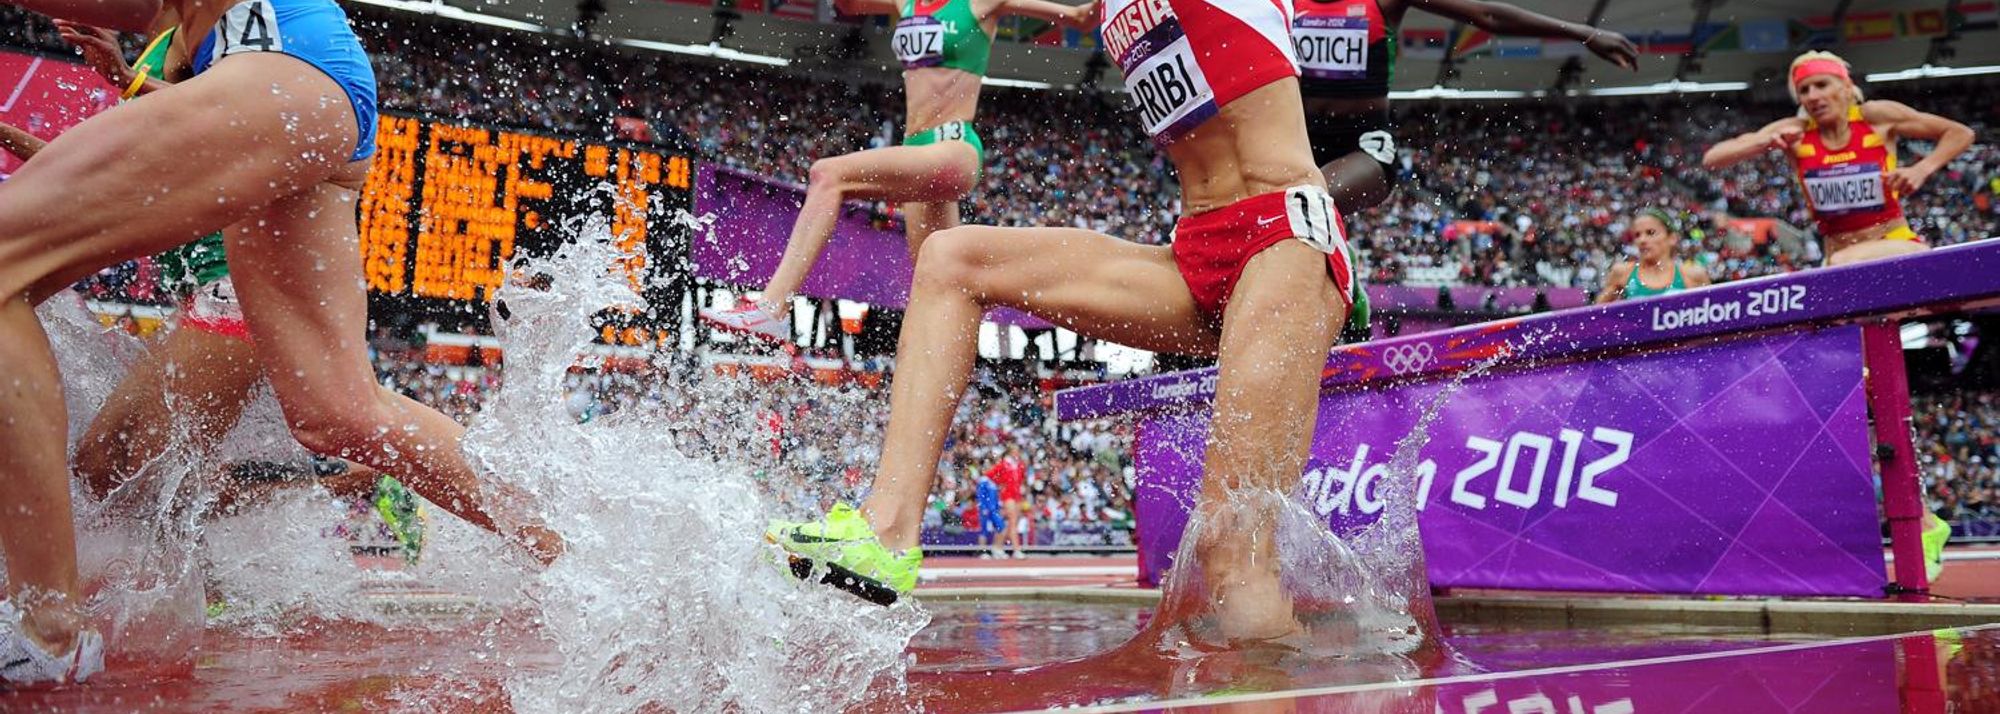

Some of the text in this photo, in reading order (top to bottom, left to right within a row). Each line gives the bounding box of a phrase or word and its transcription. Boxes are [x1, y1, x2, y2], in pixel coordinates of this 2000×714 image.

[1103, 0, 1178, 62] UNISIA
[939, 121, 961, 141] 13
[1811, 178, 1876, 206] DOMINGUEZ
[1293, 191, 1332, 245] 11
[1652, 285, 1807, 331] London 2012
[1152, 375, 1217, 400] London 20
[1301, 426, 1634, 515] ndon 2012
